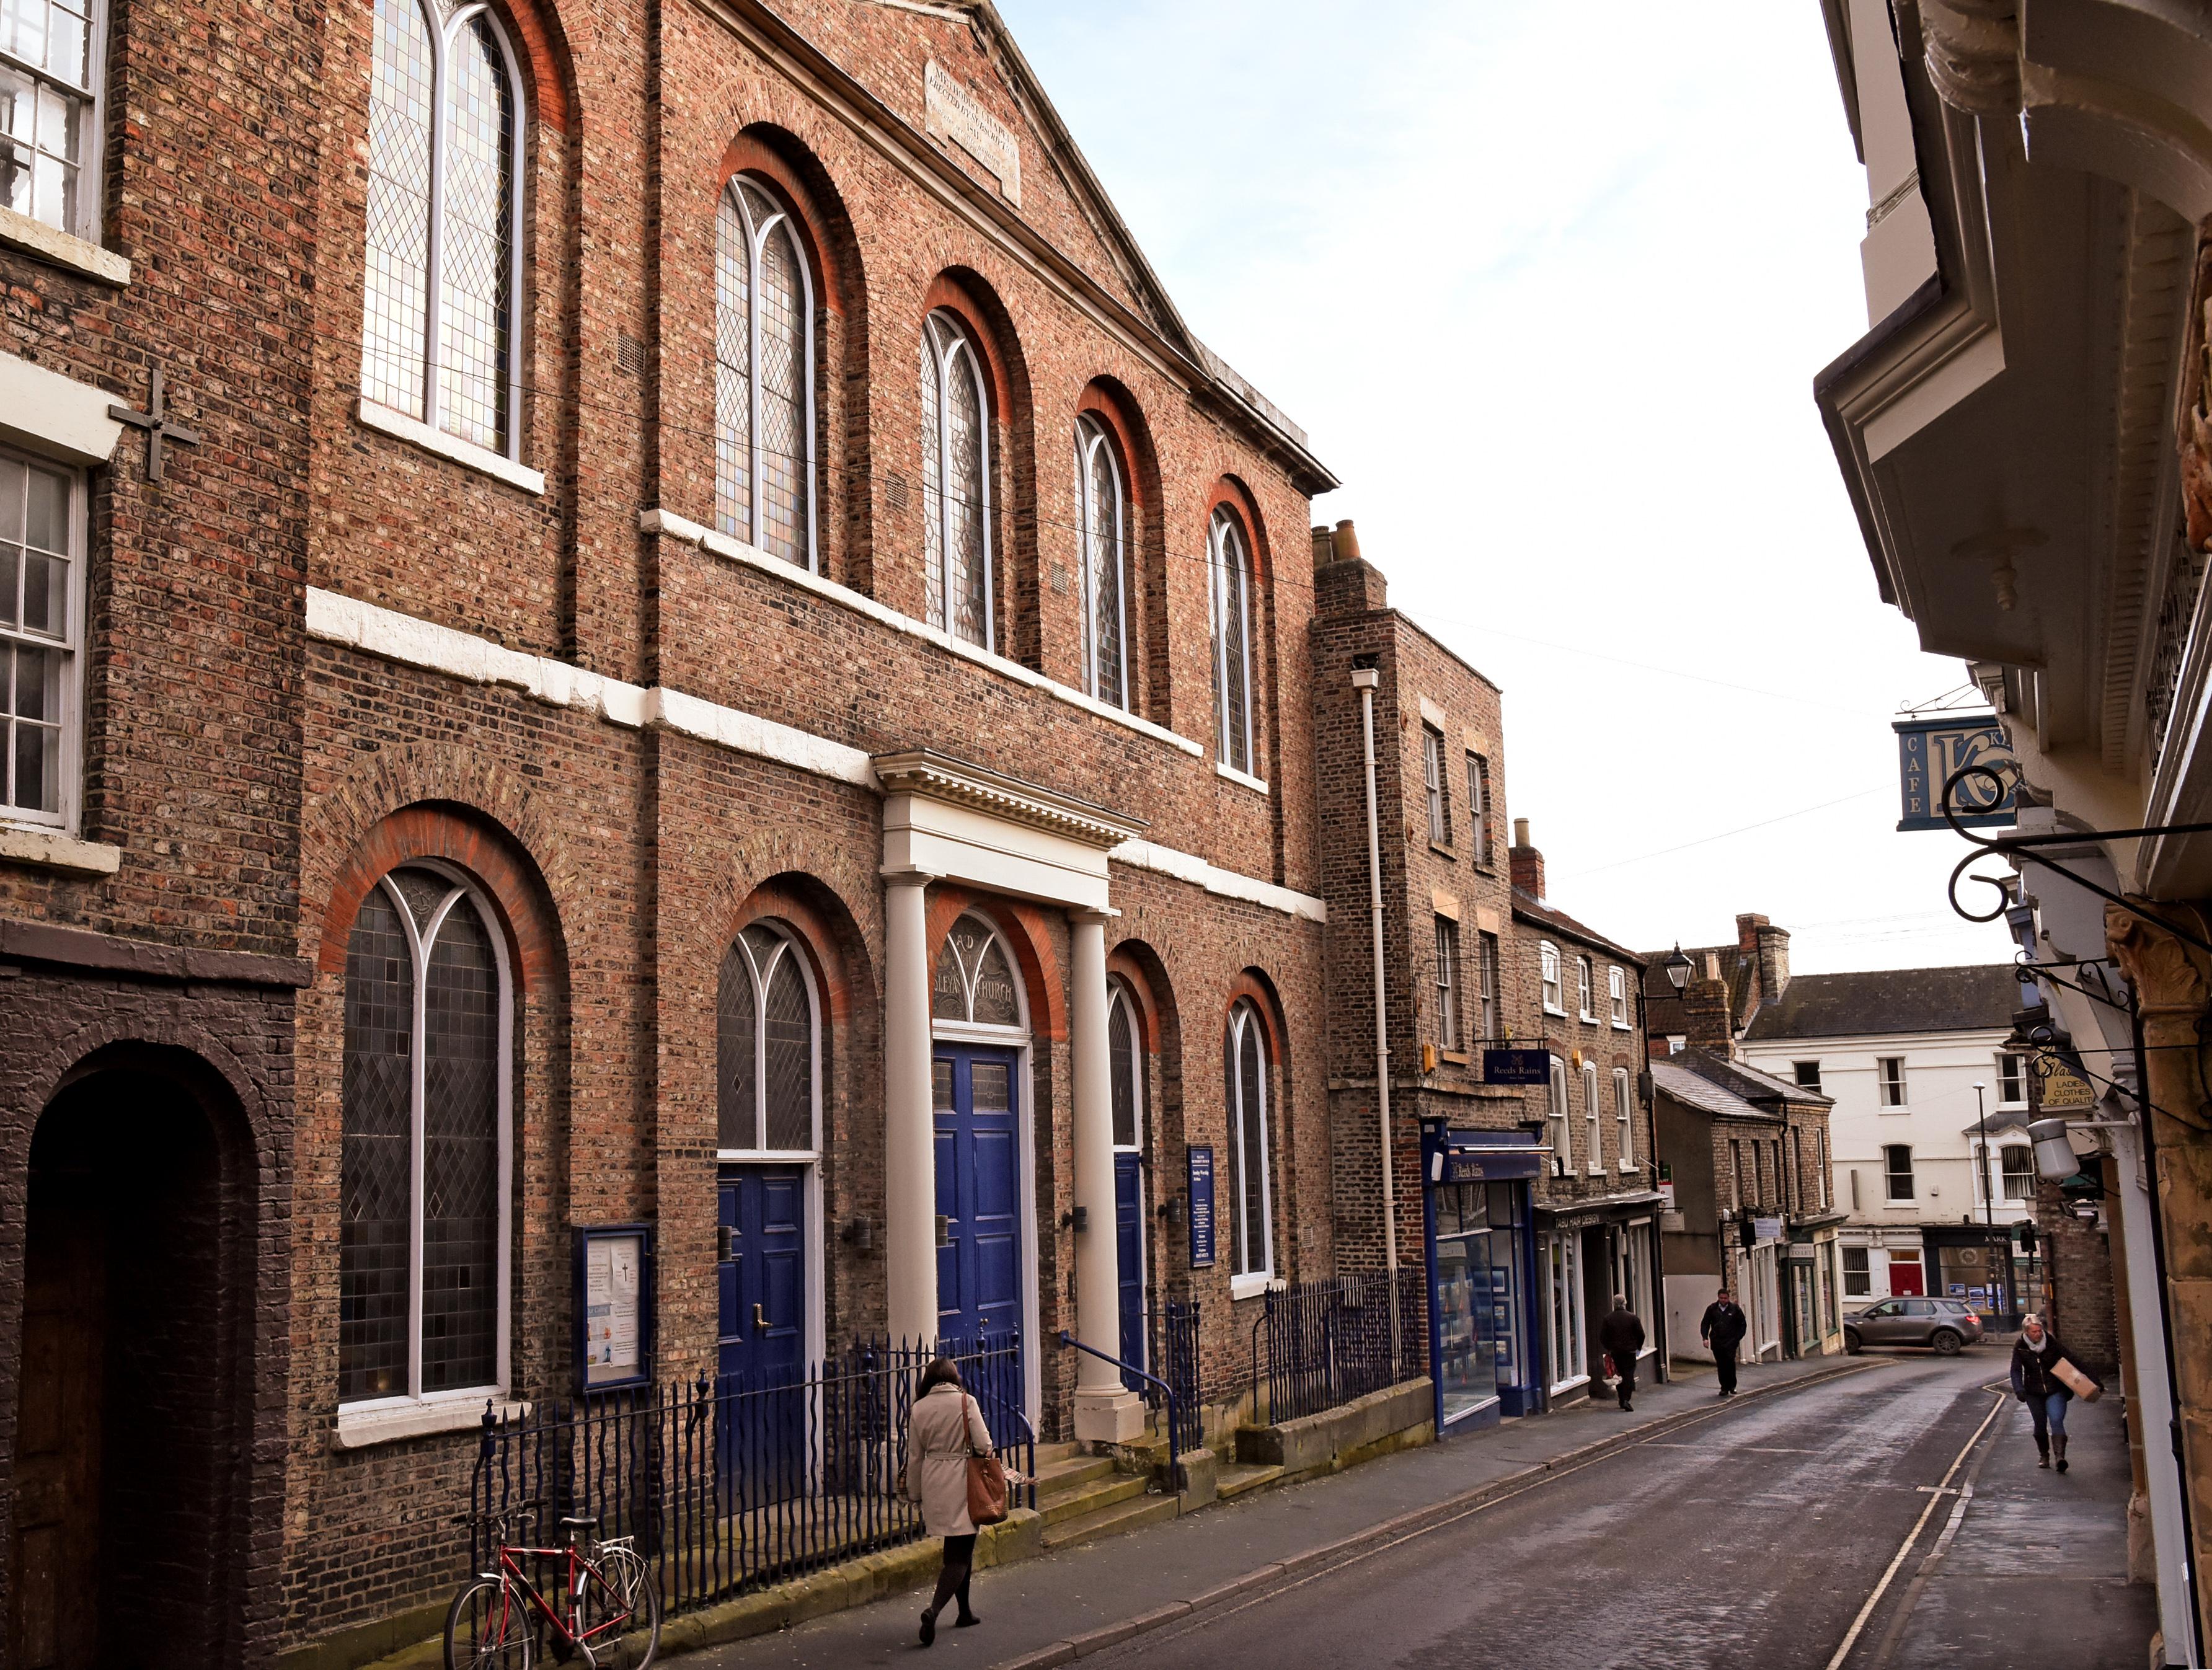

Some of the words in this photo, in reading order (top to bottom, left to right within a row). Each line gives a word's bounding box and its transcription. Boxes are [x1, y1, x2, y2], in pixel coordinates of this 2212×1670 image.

[929, 75, 960, 110] ERECTED
[961, 104, 971, 120] BY
[936, 66, 980, 115] METHODIST
[1907, 737, 1921, 813] CAFE
[960, 953, 971, 967] 811
[934, 973, 962, 993] SLEYAN
[976, 974, 1012, 1003] CHURCH
[1494, 1066, 1516, 1074] Reeds
[1519, 1066, 1541, 1074] Rains
[2054, 1089, 2090, 1097] CLOTHES
[2056, 1080, 2086, 1089] LADIES
